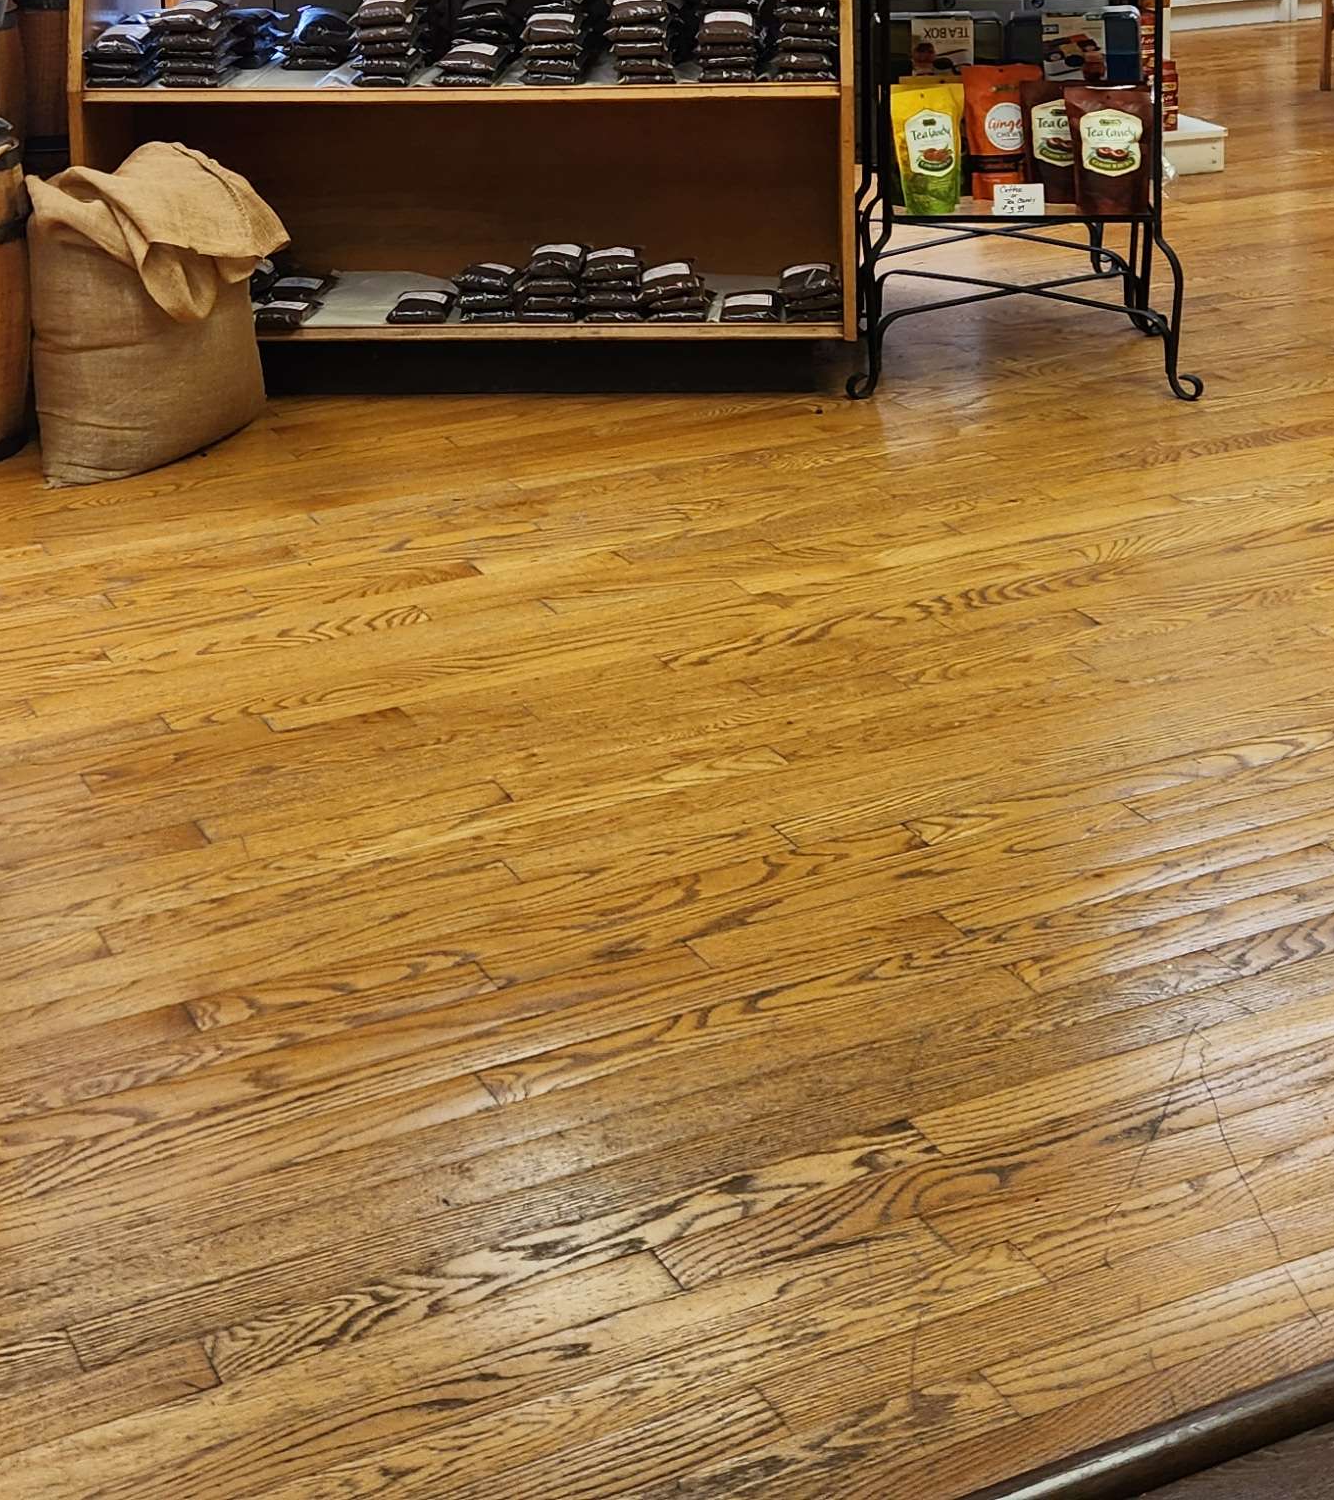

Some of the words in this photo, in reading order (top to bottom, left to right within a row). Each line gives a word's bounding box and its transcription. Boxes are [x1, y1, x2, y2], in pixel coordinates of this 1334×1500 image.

[924, 27, 947, 39] BOX
[948, 27, 970, 38] TEA
[988, 117, 1022, 133] Ginge
[1037, 117, 1054, 129] Tea
[911, 130, 929, 141] Tea
[1086, 127, 1104, 138] Tea
[1105, 127, 1137, 143] Candy
